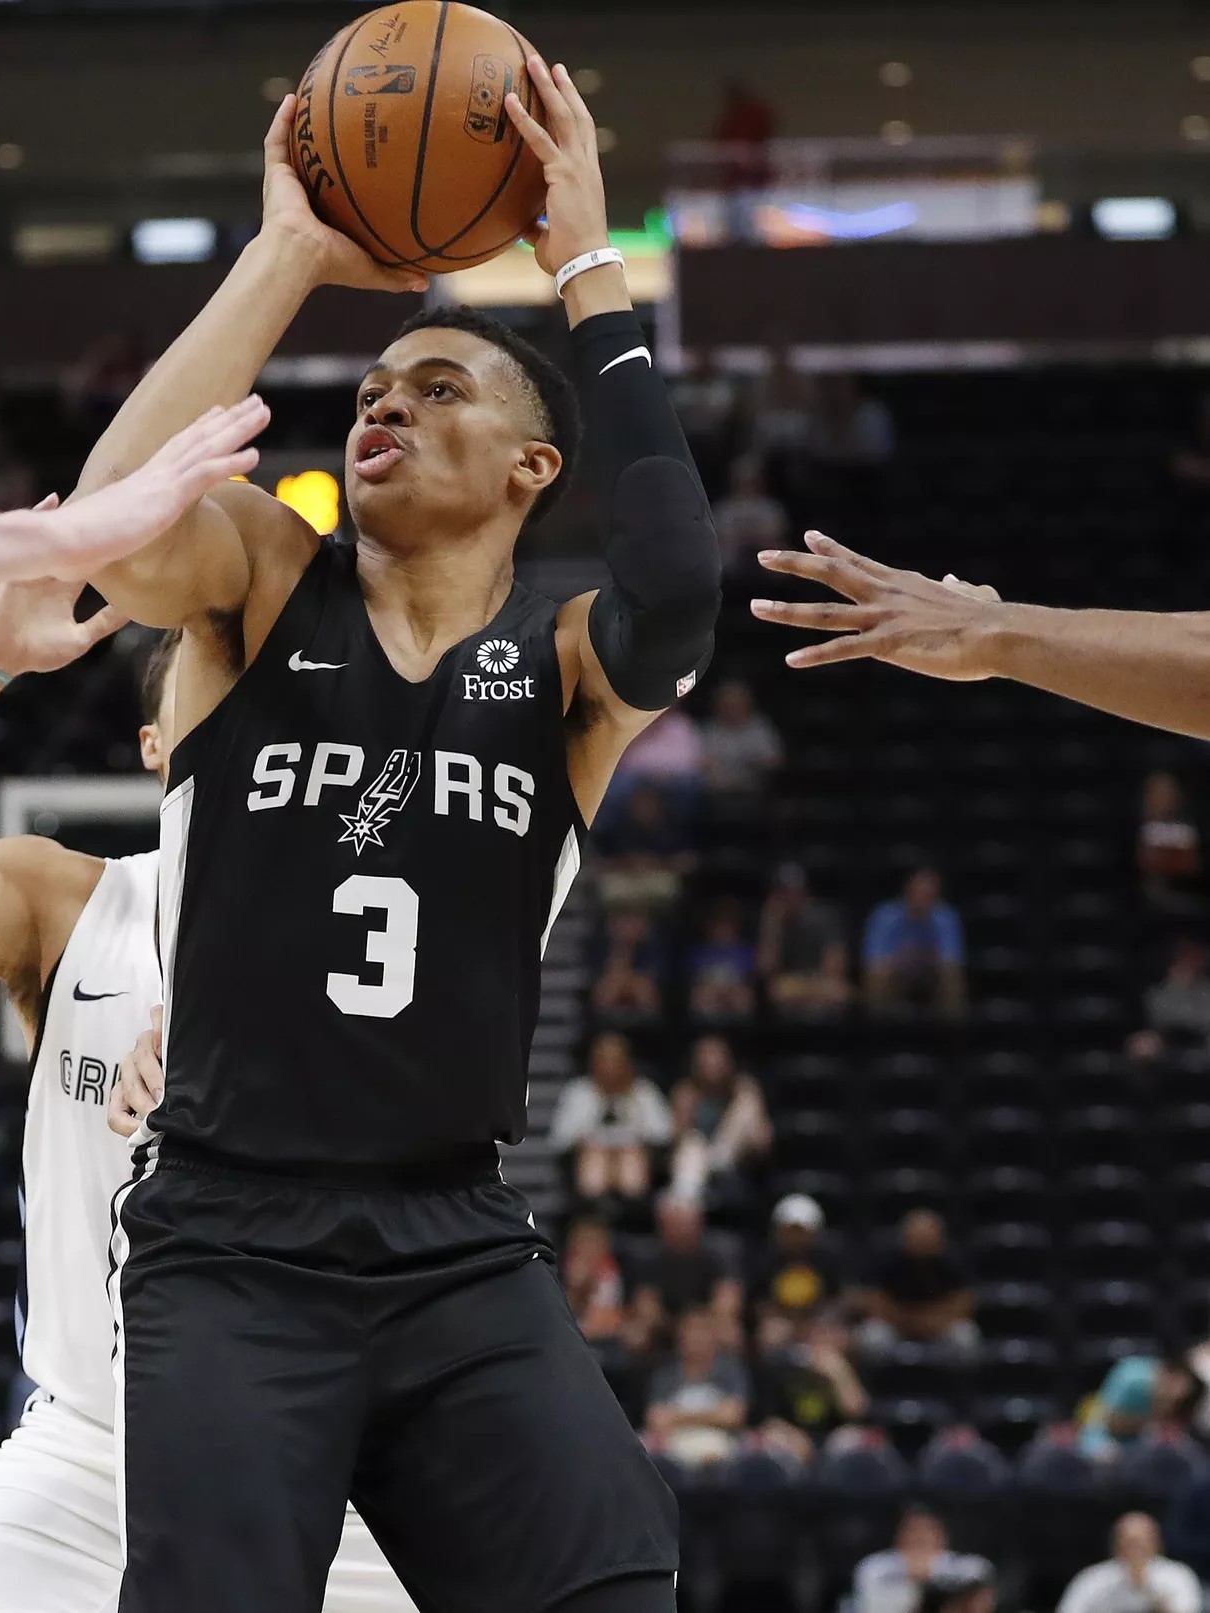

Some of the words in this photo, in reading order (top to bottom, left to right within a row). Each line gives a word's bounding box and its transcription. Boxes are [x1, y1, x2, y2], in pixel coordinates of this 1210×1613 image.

[463, 673, 535, 702] Frost
[247, 742, 536, 856] SPURS
[326, 874, 420, 1019] 3
